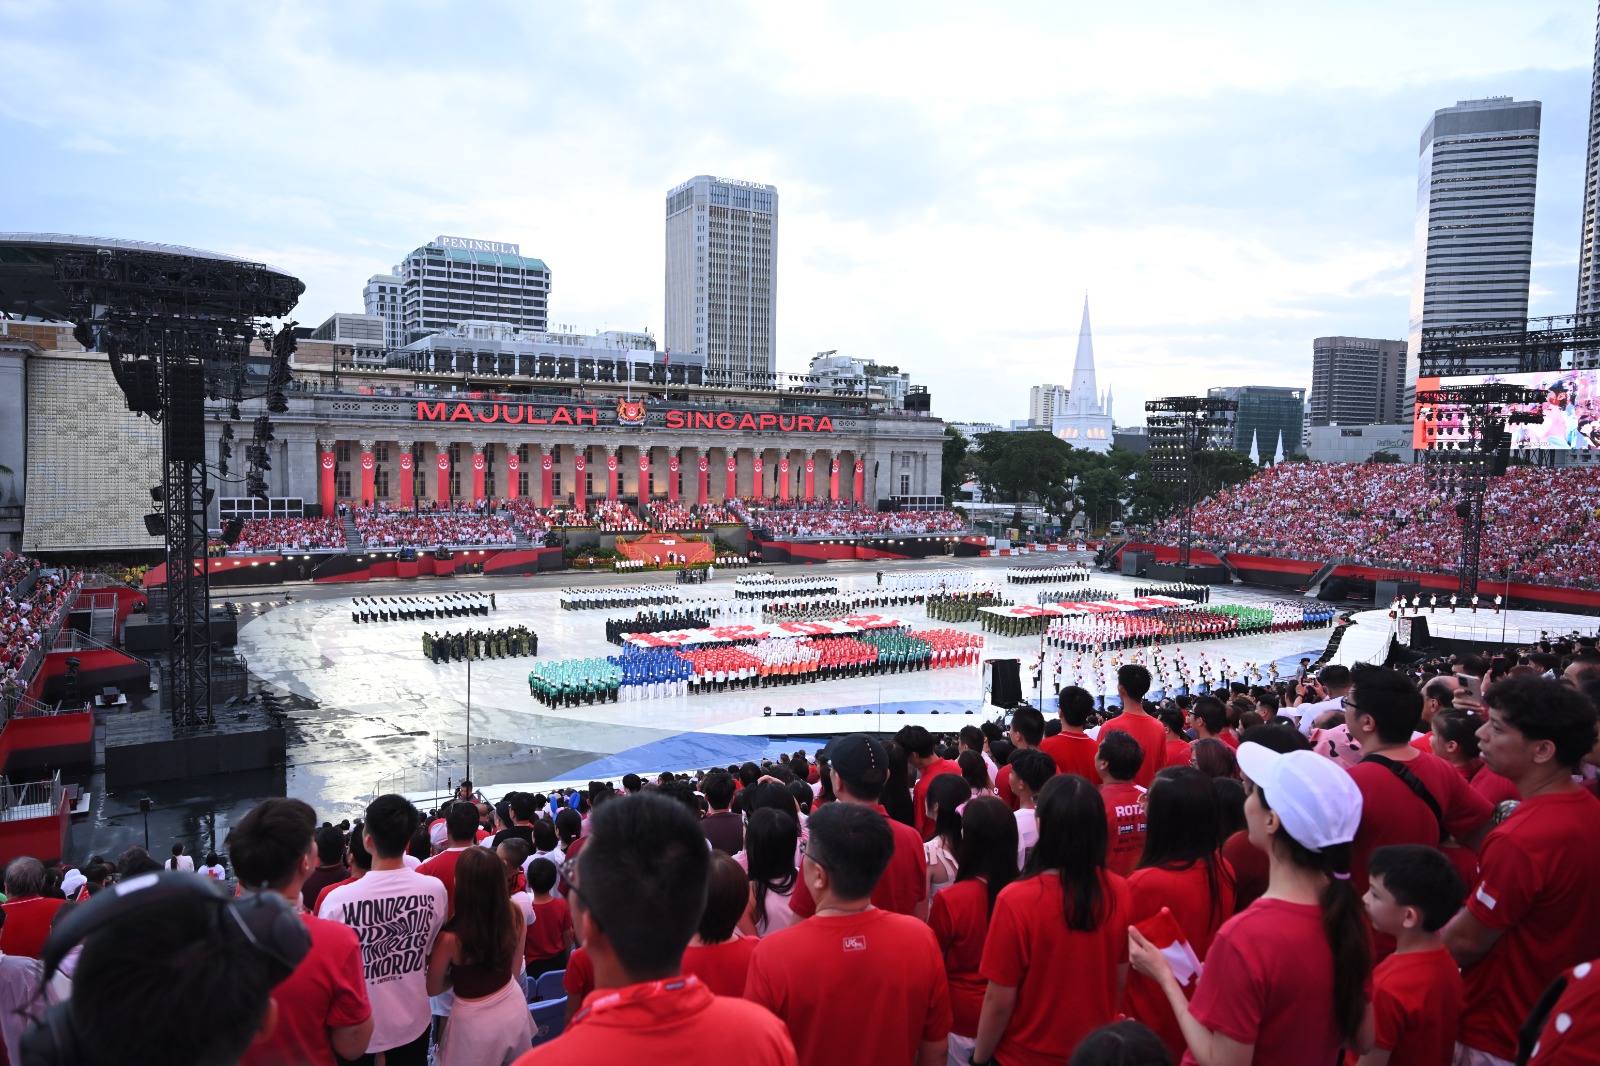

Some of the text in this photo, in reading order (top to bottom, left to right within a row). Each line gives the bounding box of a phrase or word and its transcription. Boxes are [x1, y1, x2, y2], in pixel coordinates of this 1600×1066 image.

[442, 237, 517, 254] PENINSULA
[417, 401, 835, 432] MAJULAH SINGAPURA
[1376, 439, 1411, 448] Raffles City
[342, 895, 435, 926] WONDROUS
[361, 933, 429, 964] ONDROUS
[363, 948, 424, 980] ONDROU
